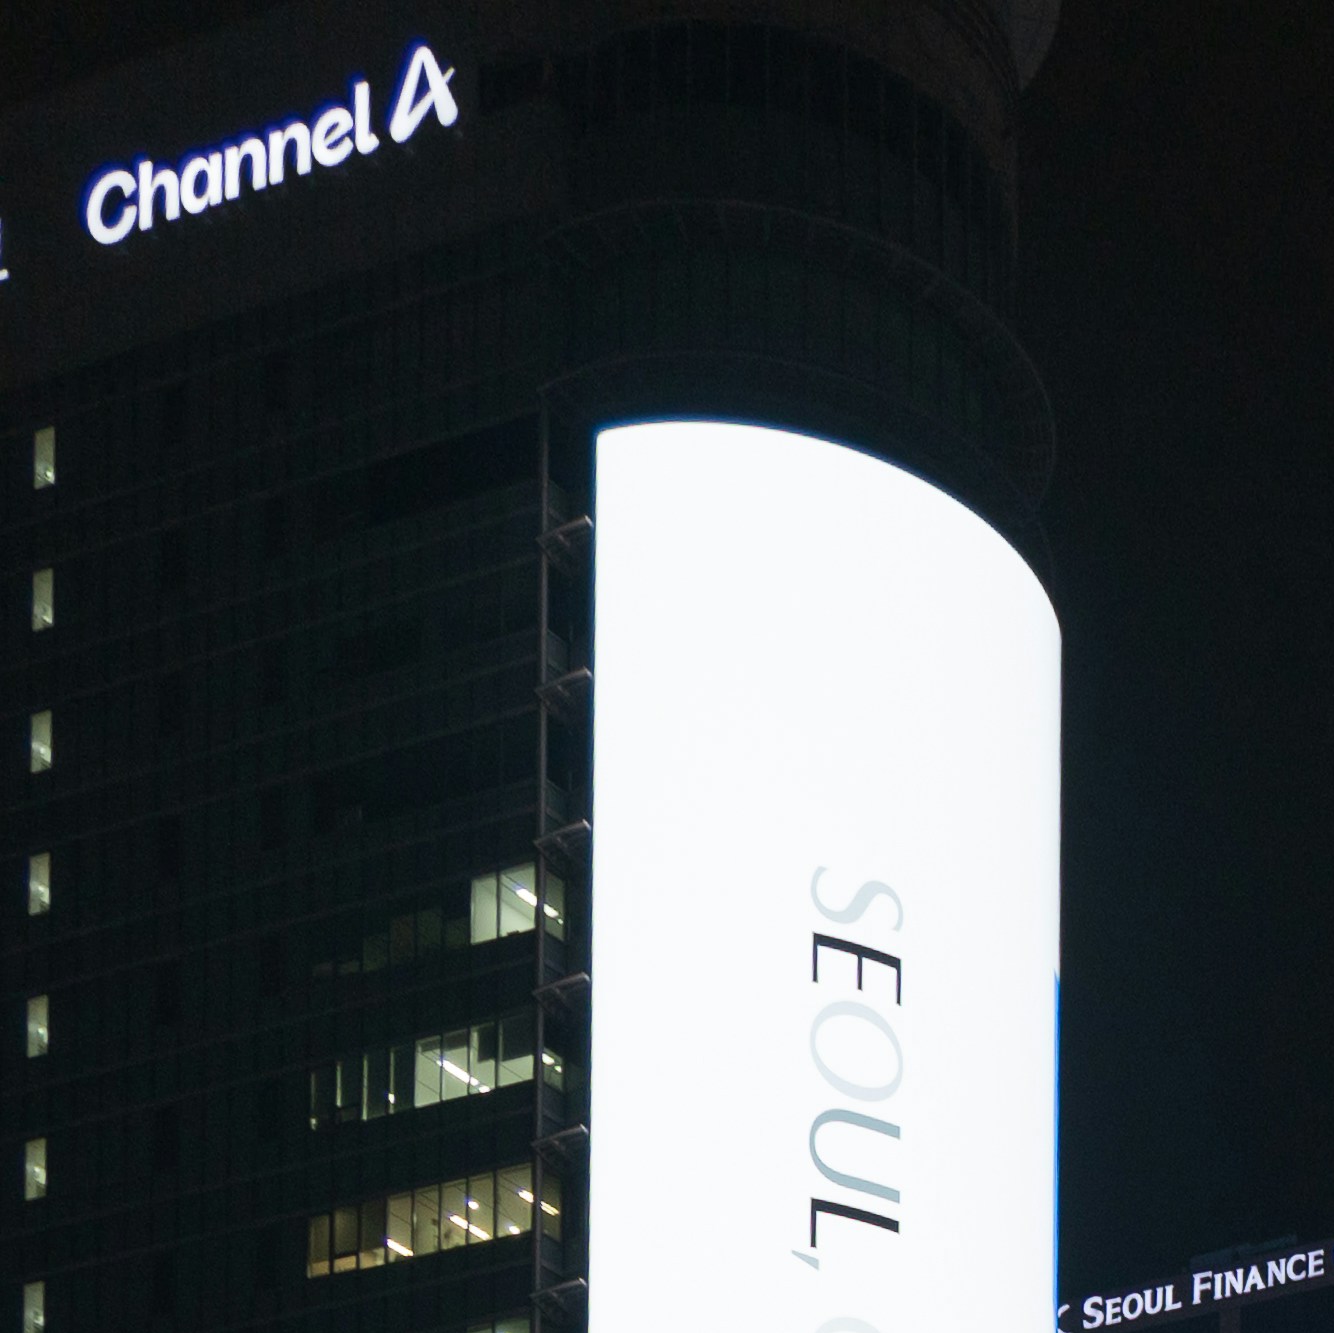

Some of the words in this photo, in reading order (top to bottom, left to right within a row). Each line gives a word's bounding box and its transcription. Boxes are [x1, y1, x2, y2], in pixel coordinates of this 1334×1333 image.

[87, 80, 379, 245] Channel
[390, 45, 458, 143] A
[791, 865, 904, 1271] SEOUL,
[1082, 1285, 1182, 1330] SEOUL
[1192, 1249, 1325, 1306] FINANCE
